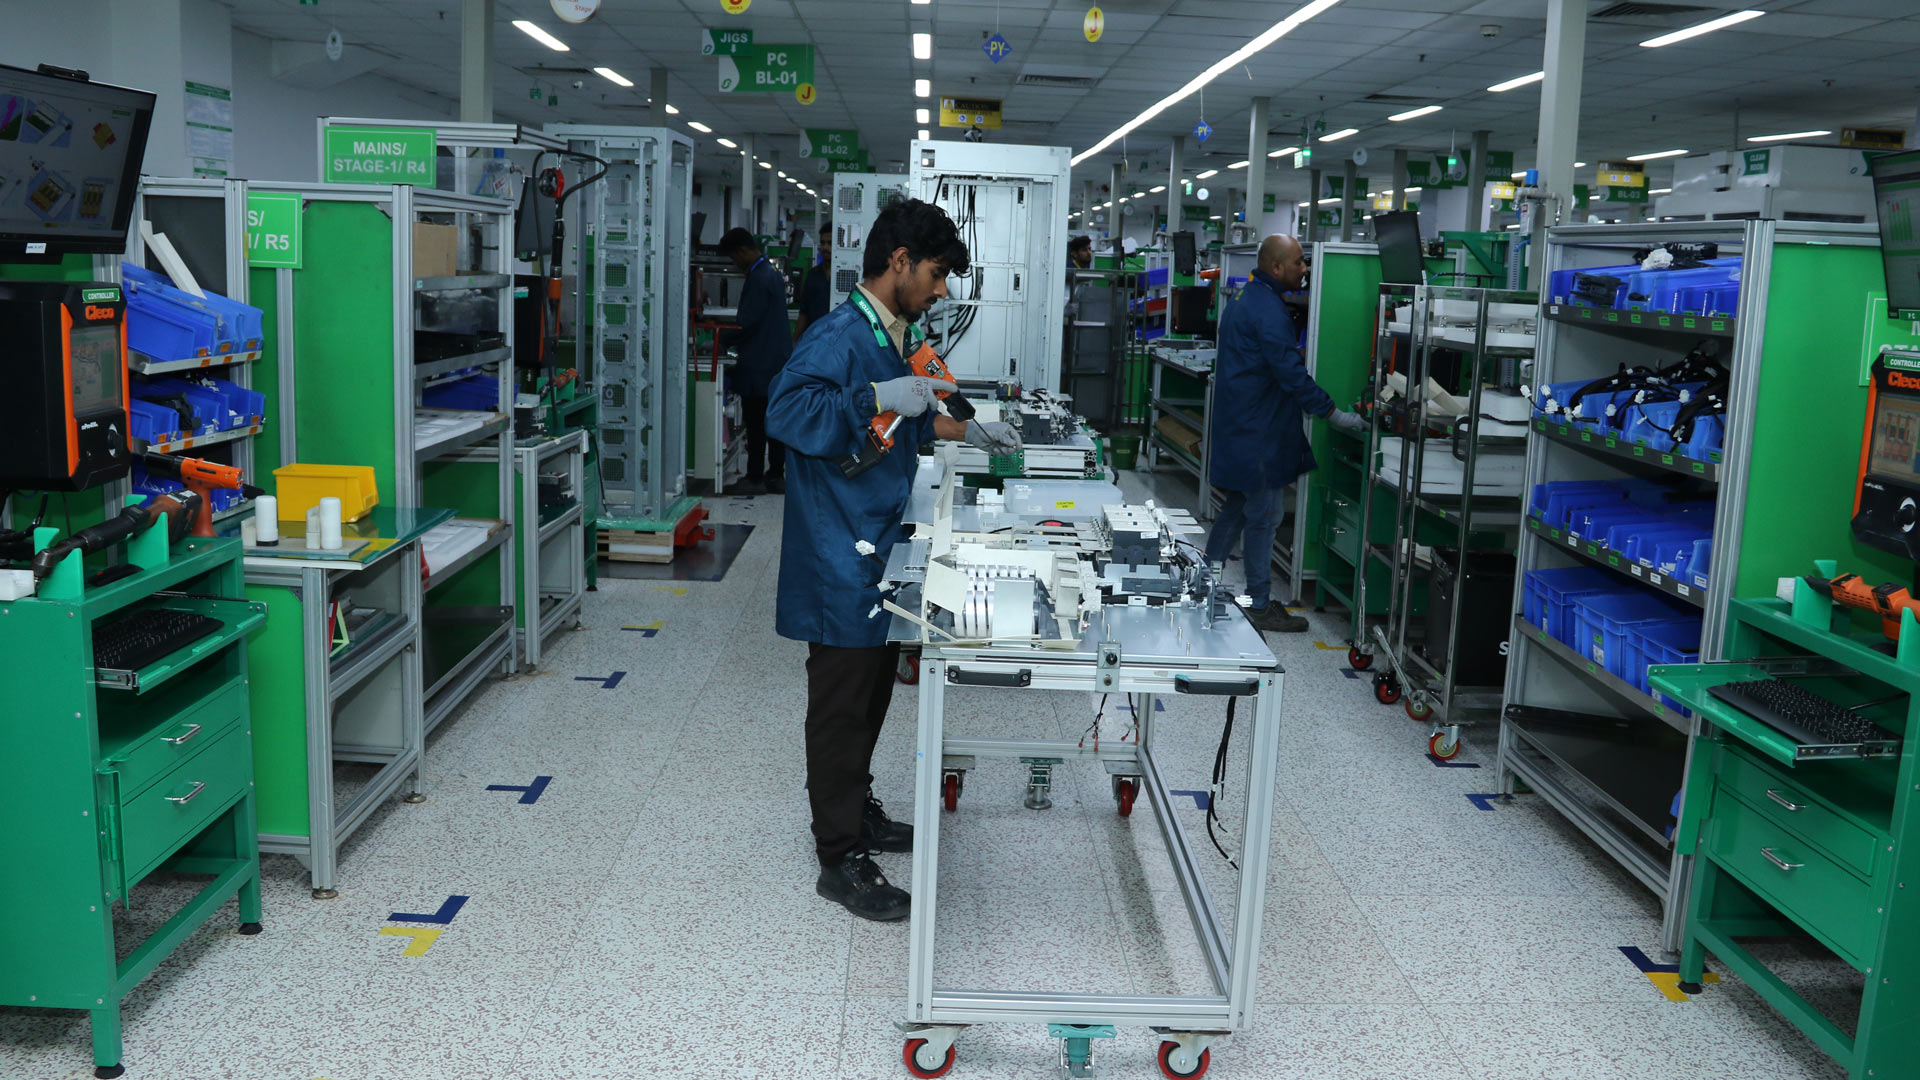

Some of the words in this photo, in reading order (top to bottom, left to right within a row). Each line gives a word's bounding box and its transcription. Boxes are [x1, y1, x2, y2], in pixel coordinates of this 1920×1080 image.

[720, 33, 748, 43] JIGS
[990, 41, 1005, 56] PY
[767, 52, 788, 66] PC
[755, 71, 797, 85] BL-01
[801, 86, 811, 100] J
[828, 134, 841, 143] PC
[353, 141, 407, 156] MAINS/
[821, 145, 848, 154] BL-02
[334, 158, 403, 173] STAGE-1/
[407, 161, 426, 174] R4
[265, 233, 289, 250] R5
[85, 305, 115, 320] Cleco
